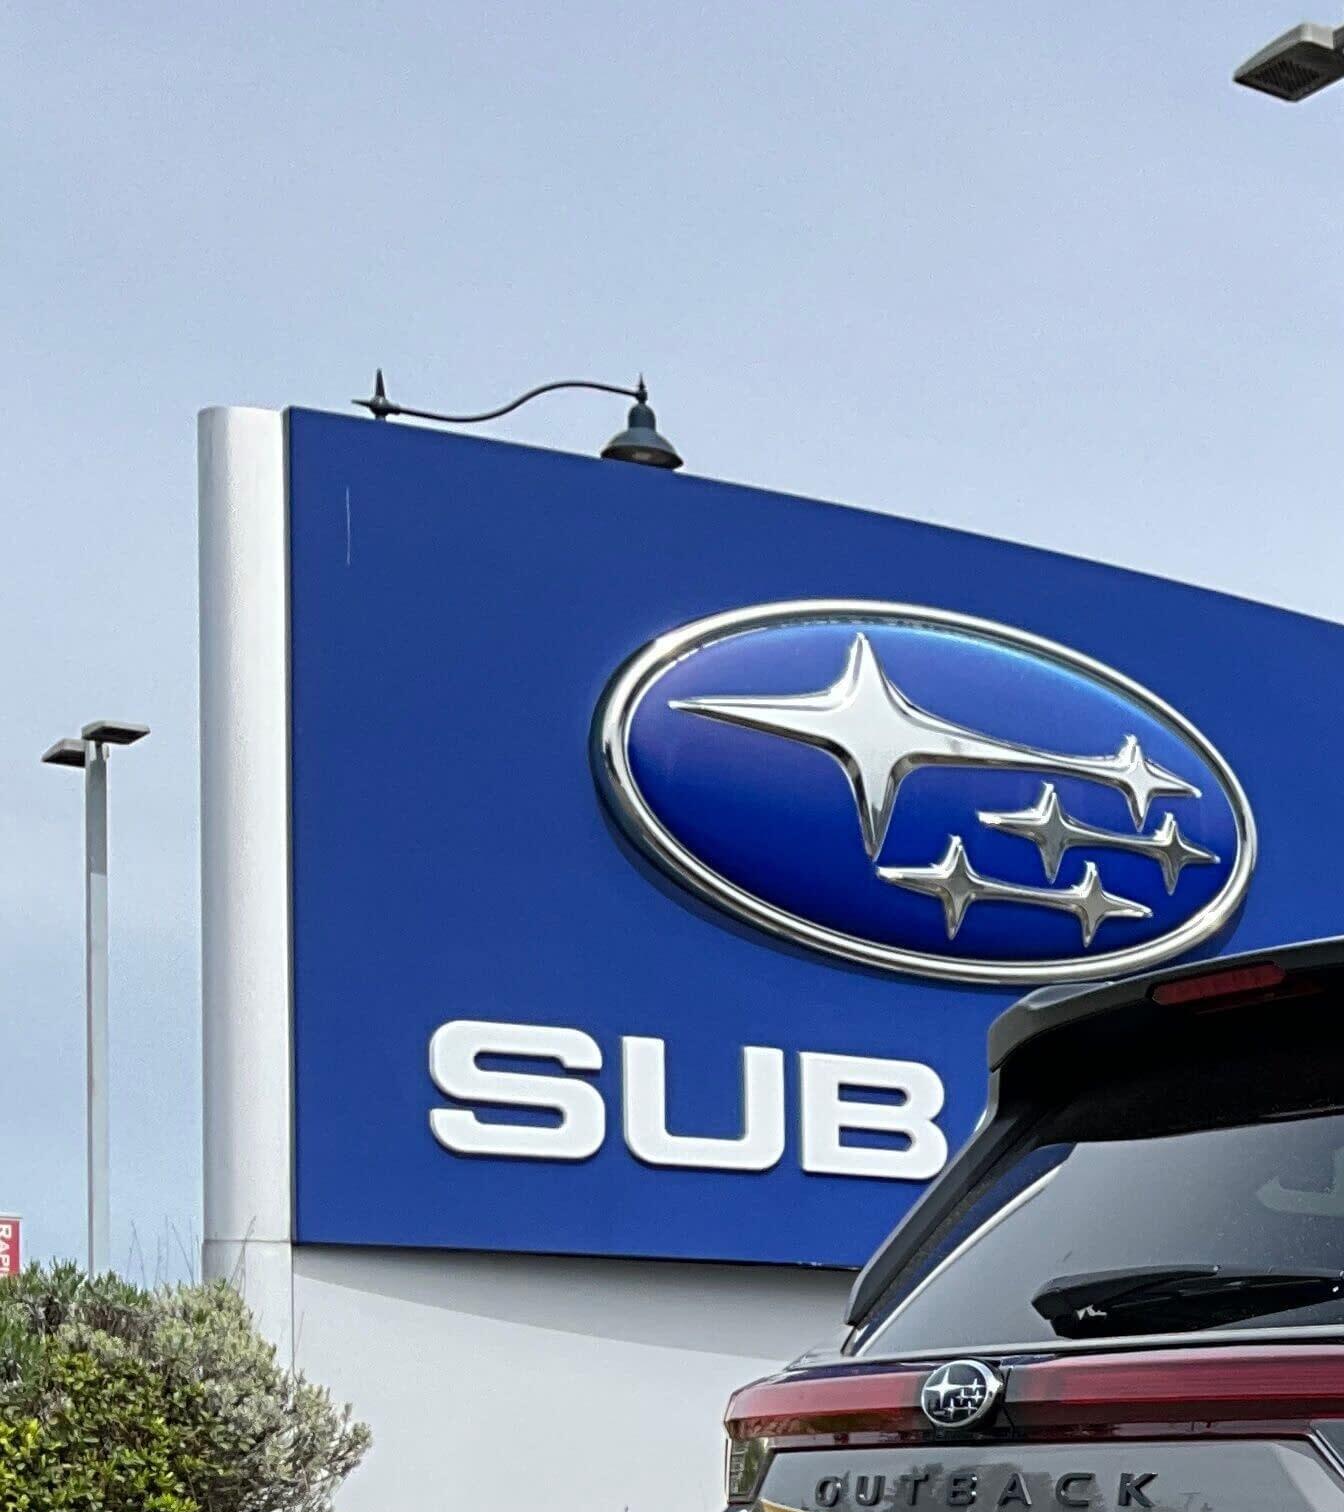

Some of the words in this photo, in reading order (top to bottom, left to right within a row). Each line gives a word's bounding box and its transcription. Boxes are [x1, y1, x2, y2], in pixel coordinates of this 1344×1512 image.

[429, 1020, 949, 1181] SUB
[0, 1224, 12, 1277] RAPI
[814, 1472, 1160, 1508] OUTBACK
